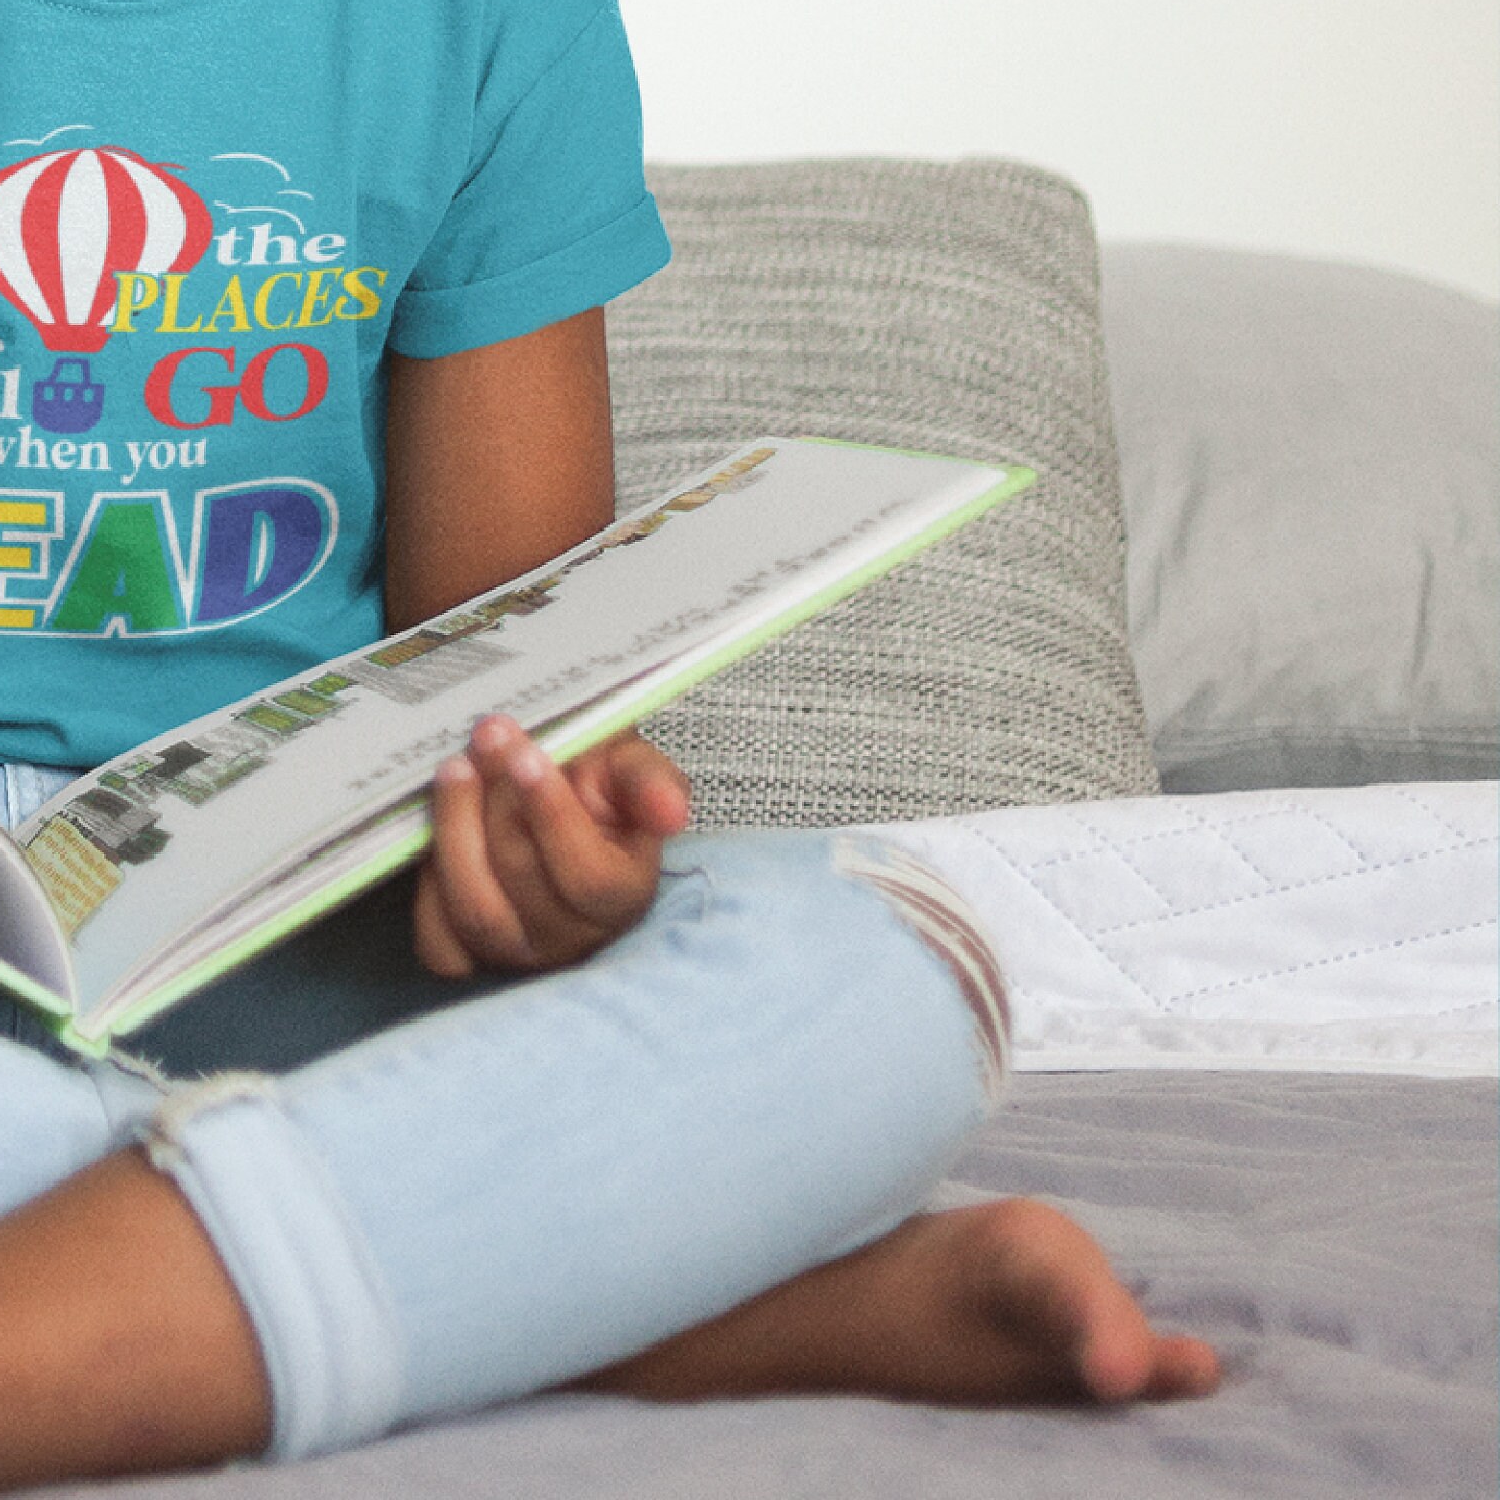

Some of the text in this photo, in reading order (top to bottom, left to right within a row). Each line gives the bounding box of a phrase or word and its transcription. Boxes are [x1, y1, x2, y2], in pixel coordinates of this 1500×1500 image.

[214, 222, 347, 265] the
[111, 266, 388, 334] PLACES
[144, 343, 329, 430] GO
[122, 437, 206, 486] you
